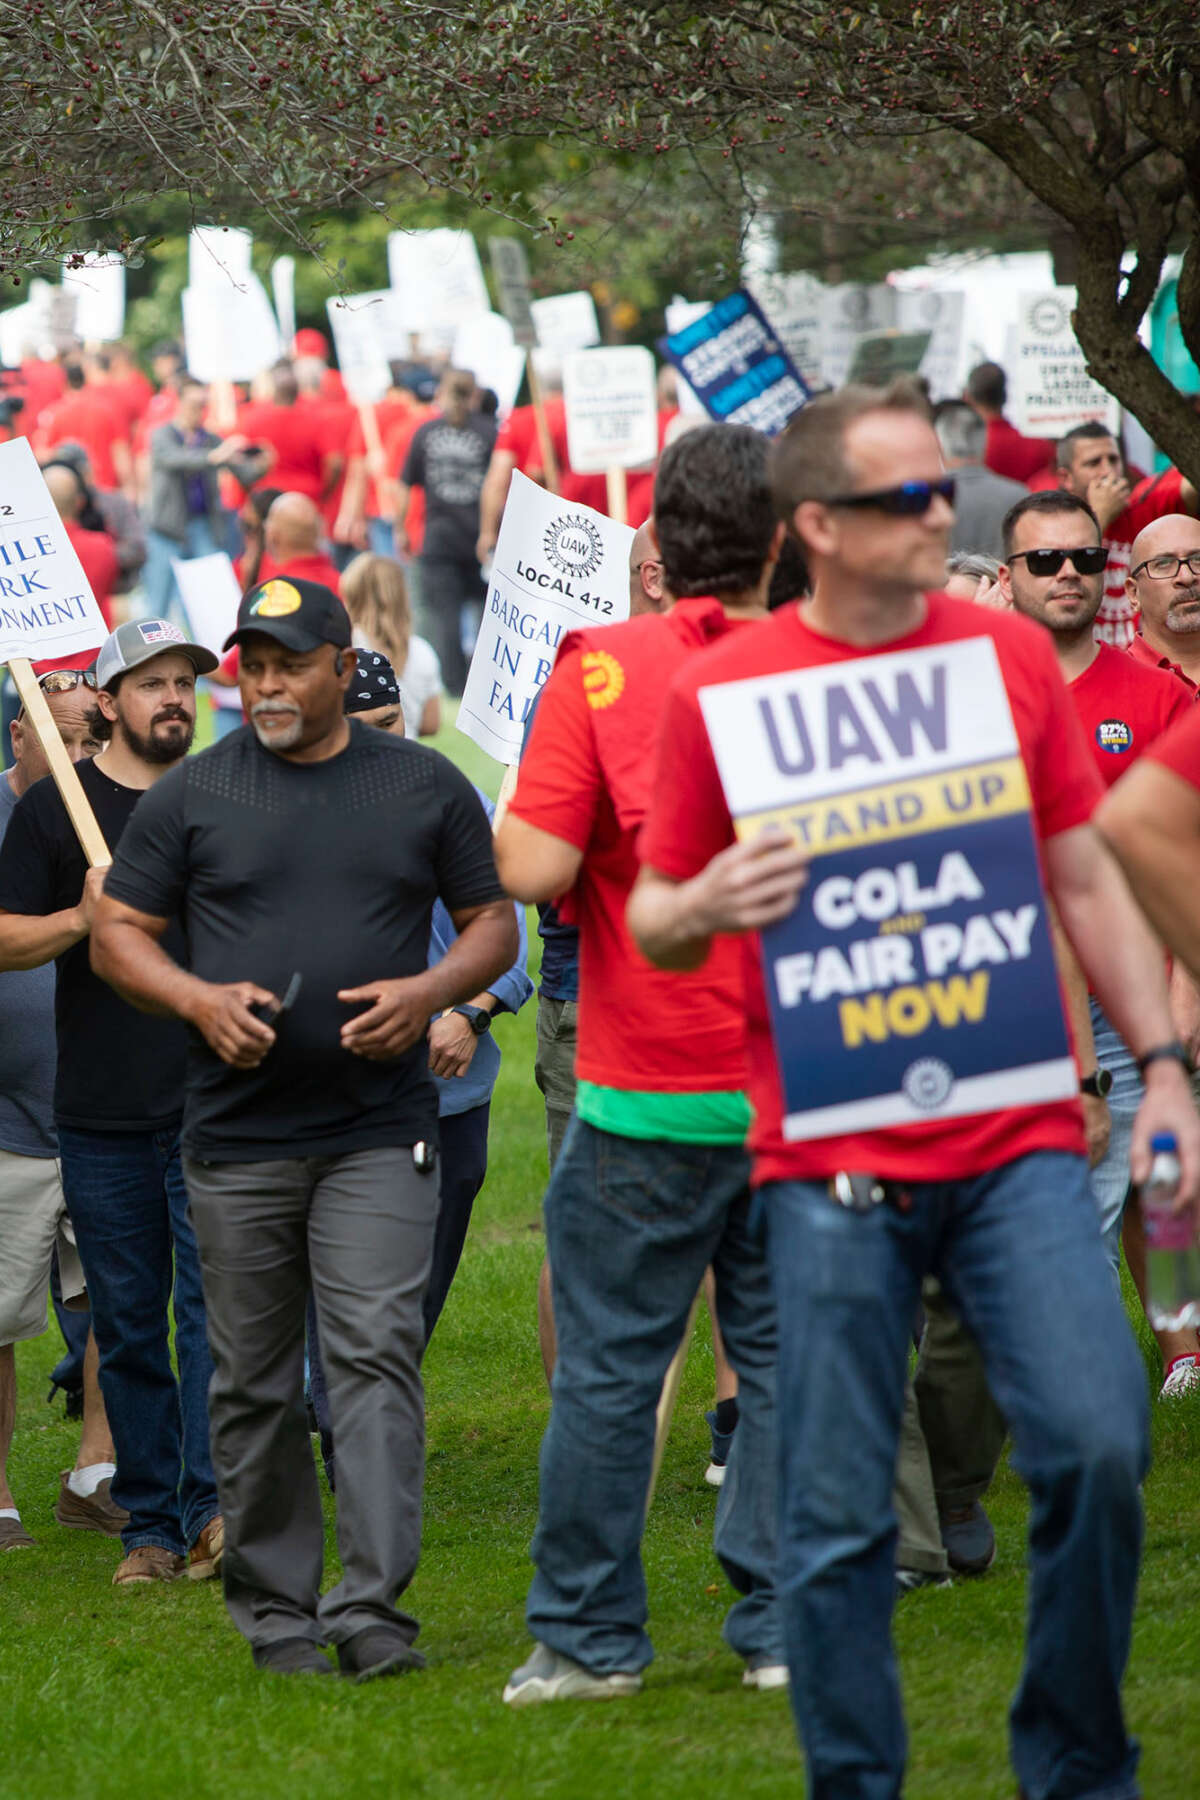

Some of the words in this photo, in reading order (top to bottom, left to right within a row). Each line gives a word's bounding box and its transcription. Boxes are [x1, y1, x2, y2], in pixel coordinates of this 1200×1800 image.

[1022, 343, 1082, 357] STELLA
[561, 535, 590, 558] UAW
[516, 560, 575, 599] LOCAL
[579, 591, 614, 616] 412
[490, 588, 563, 649] BARGAI
[492, 634, 522, 677] IN
[533, 657, 551, 687] B
[488, 679, 532, 724] FAI
[757, 663, 949, 778] UAW
[1100, 723, 1128, 735] 97%
[942, 775, 1007, 813] UP
[812, 851, 986, 931] COLA
[773, 934, 918, 1009] FAIR
[921, 904, 1039, 977] PAY
[838, 970, 991, 1049] NOW
